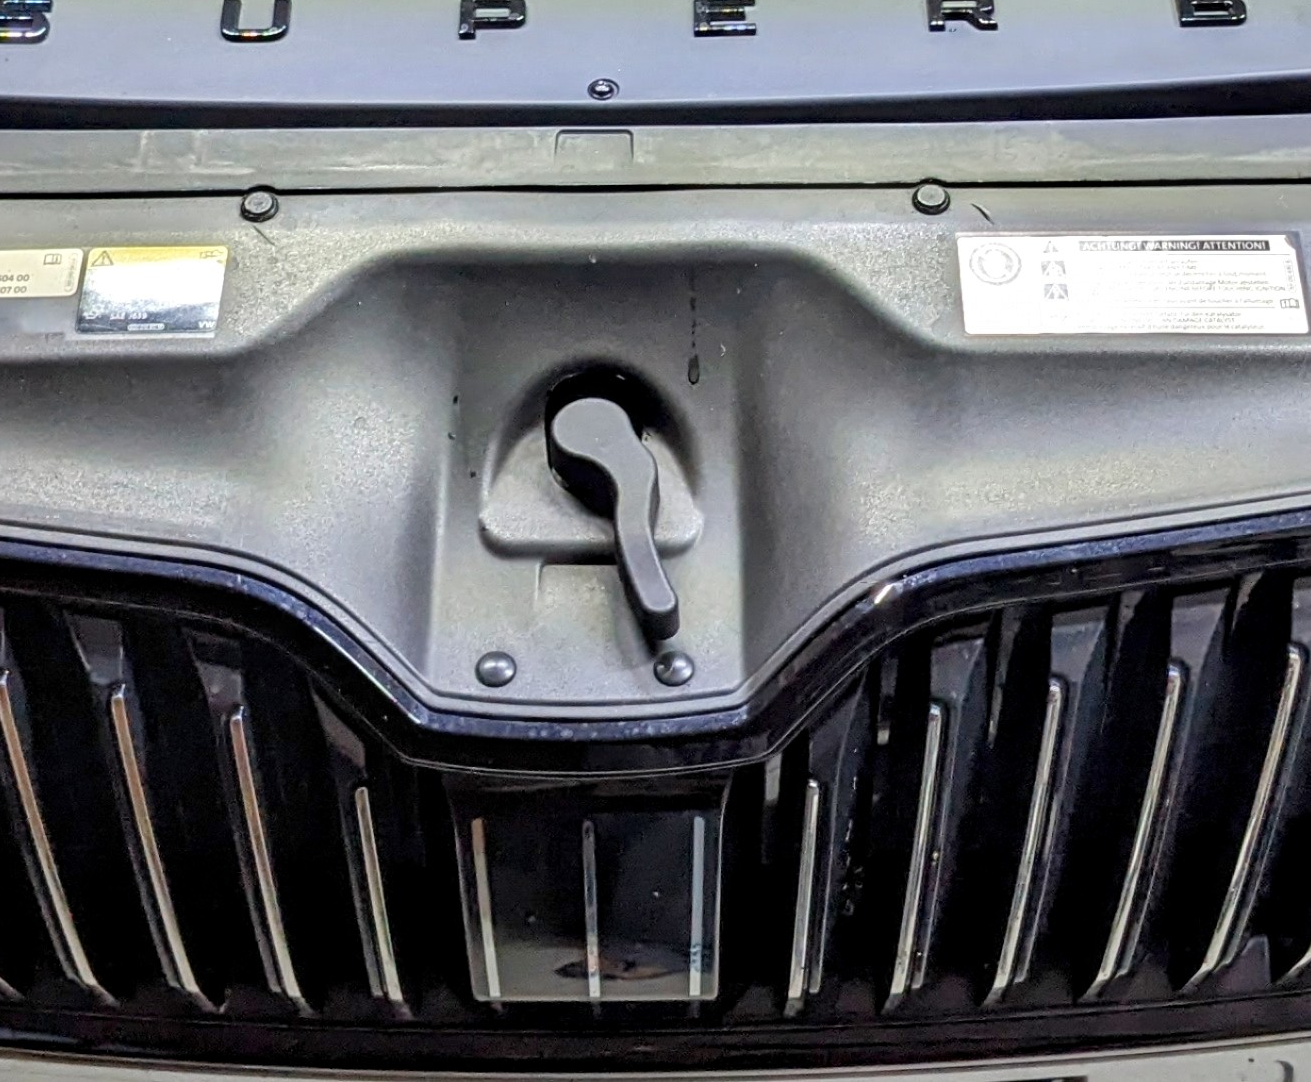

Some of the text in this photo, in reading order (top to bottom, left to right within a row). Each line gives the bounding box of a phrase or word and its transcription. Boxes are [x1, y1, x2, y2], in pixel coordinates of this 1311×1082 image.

[1142, 241, 1200, 251] WARNING!
[1202, 240, 1266, 250] ATTENTION!
[16, 274, 30, 282] 00
[13, 285, 28, 294] 00
[198, 320, 216, 329] VW
